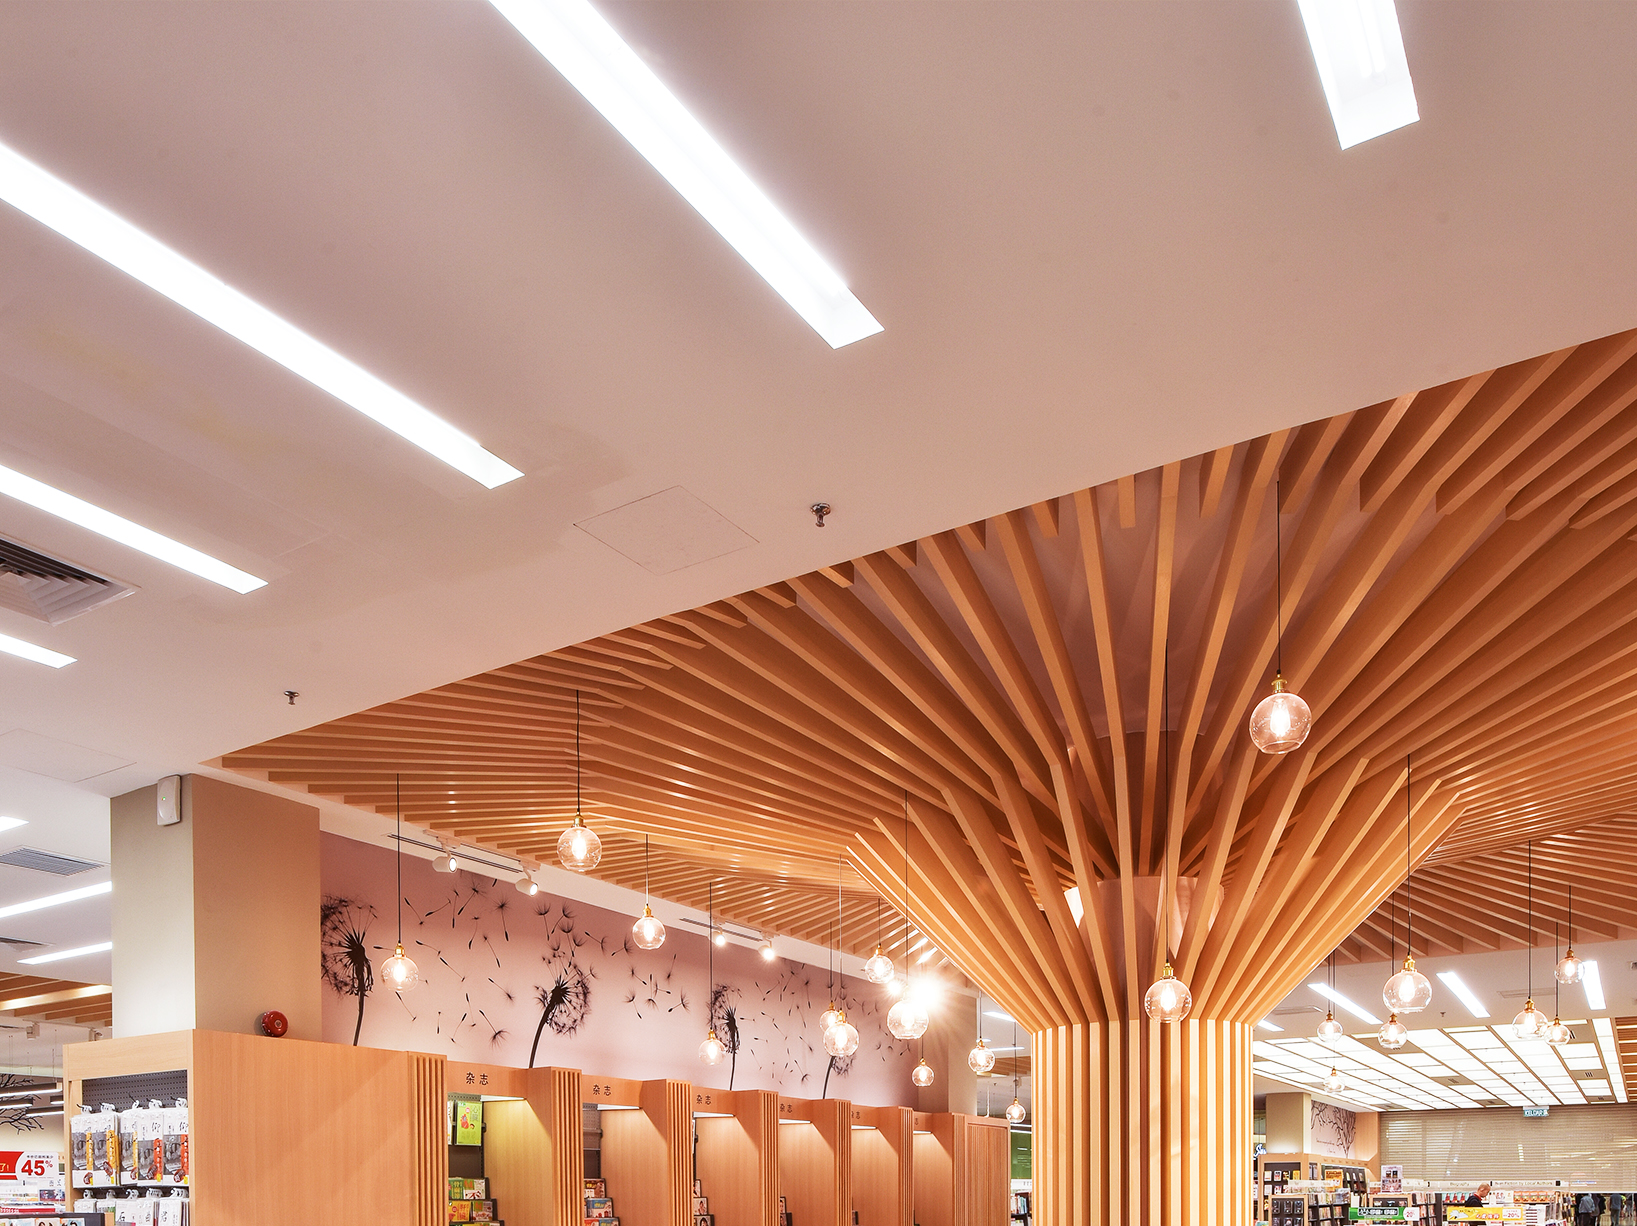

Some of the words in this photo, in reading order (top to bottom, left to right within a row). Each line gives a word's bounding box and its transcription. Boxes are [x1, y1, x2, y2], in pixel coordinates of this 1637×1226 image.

[465, 1072, 489, 1086] 杂志
[592, 1084, 612, 1096] 杂志
[696, 1094, 711, 1105] 杂志
[780, 1103, 793, 1113] 杂志
[21, 1160, 53, 1176] 45%
